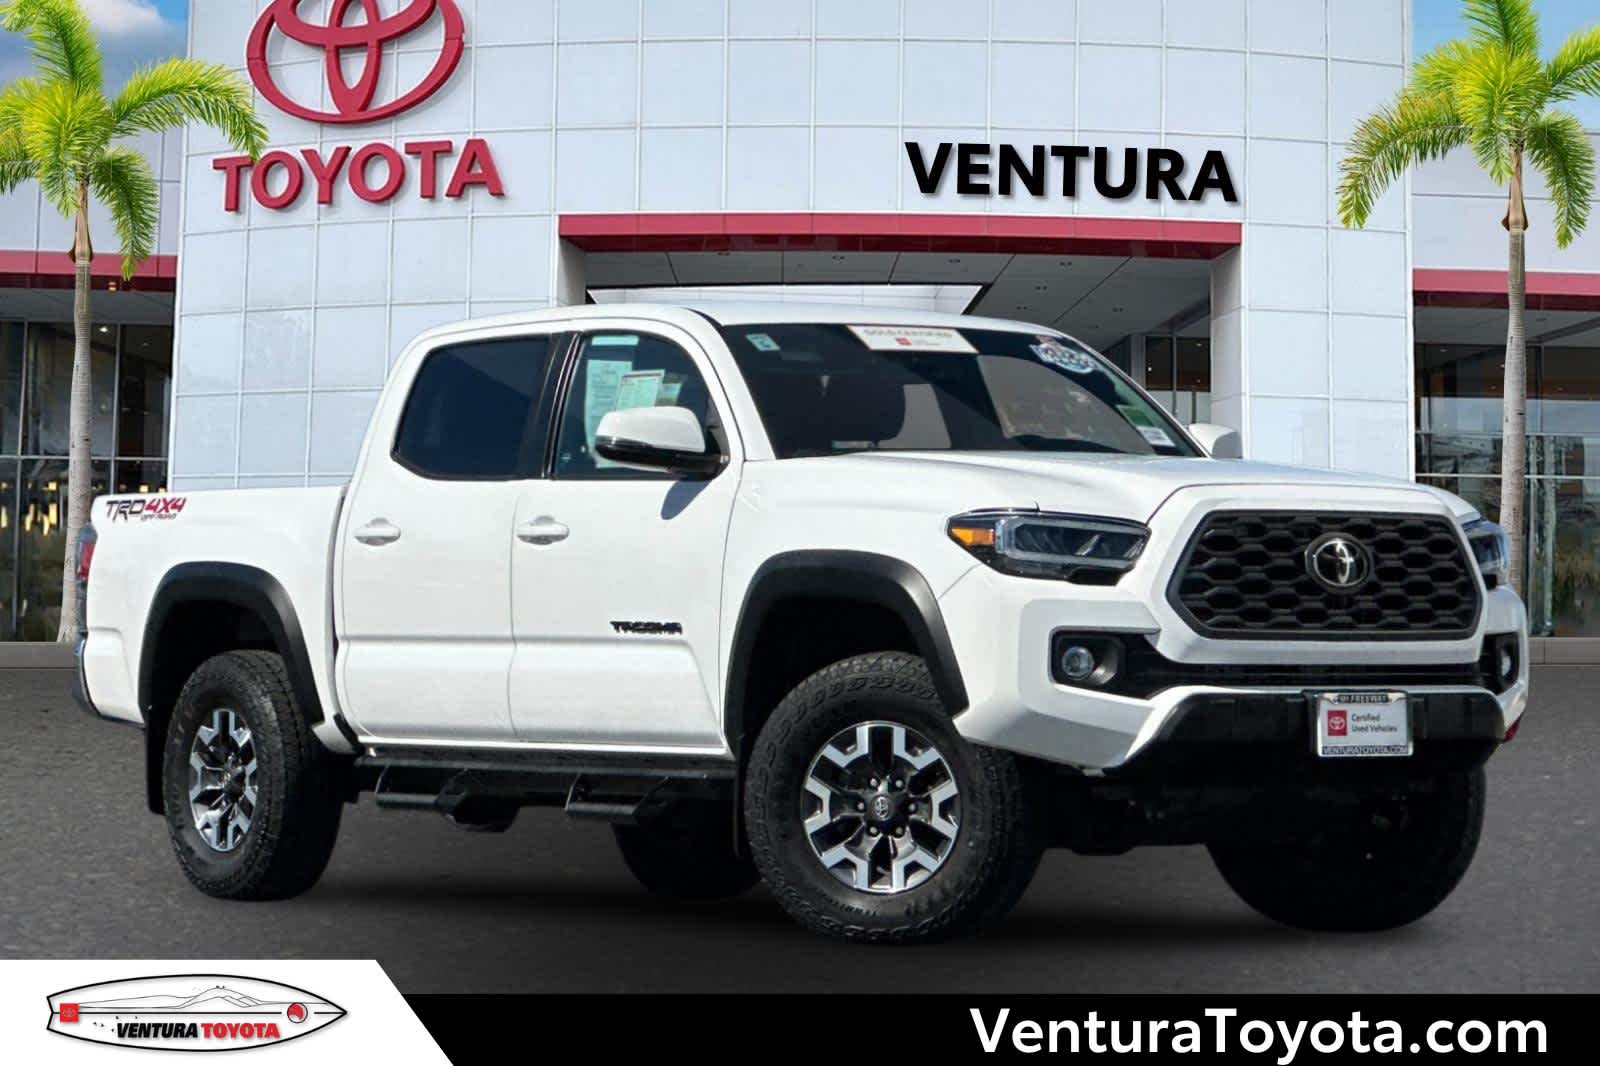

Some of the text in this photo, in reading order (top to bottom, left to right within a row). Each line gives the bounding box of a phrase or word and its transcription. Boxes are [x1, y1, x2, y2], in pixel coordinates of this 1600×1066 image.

[212, 138, 505, 213] TOYOTA
[904, 142, 1239, 203] VENTURA
[1351, 713, 1381, 722] Certified
[1351, 725, 1398, 733] Used Vehicles
